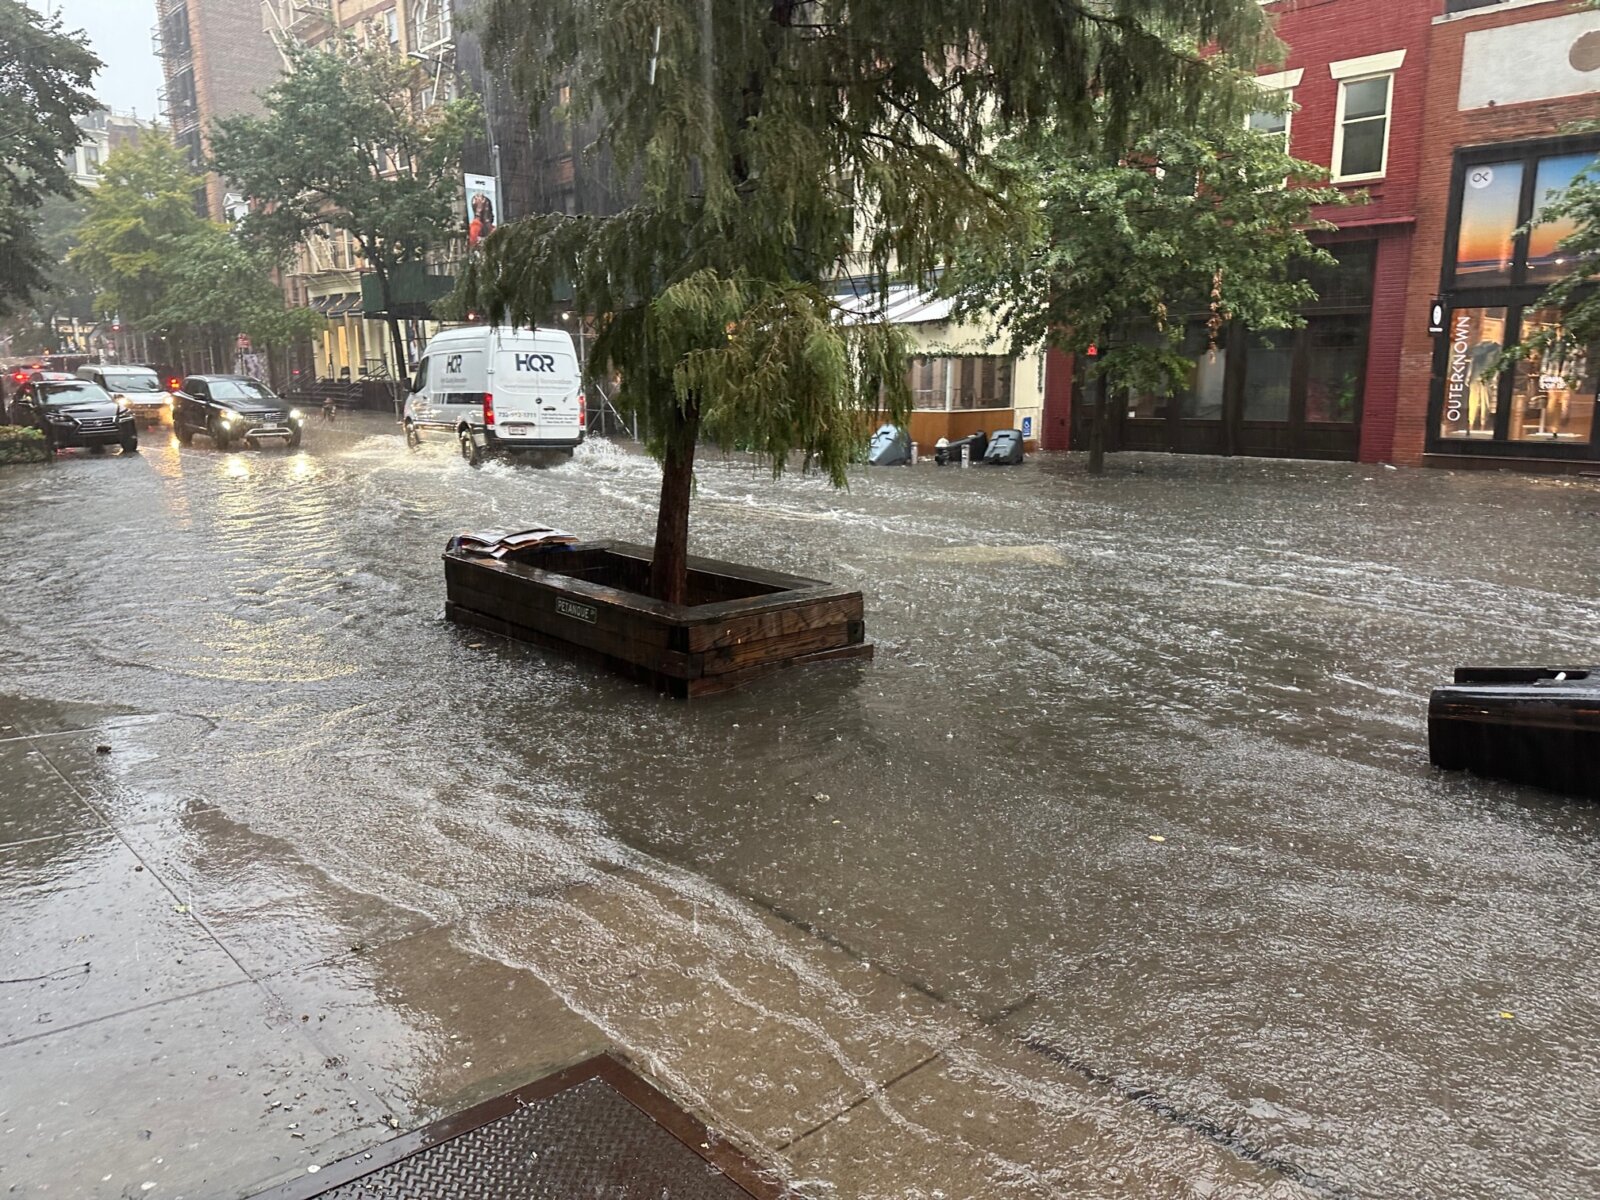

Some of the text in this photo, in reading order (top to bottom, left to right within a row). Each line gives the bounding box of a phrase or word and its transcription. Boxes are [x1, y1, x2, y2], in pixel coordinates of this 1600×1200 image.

[446, 354, 462, 374] HQR
[515, 353, 556, 373] HQR
[1447, 316, 1471, 421] OUTERKNOWN
